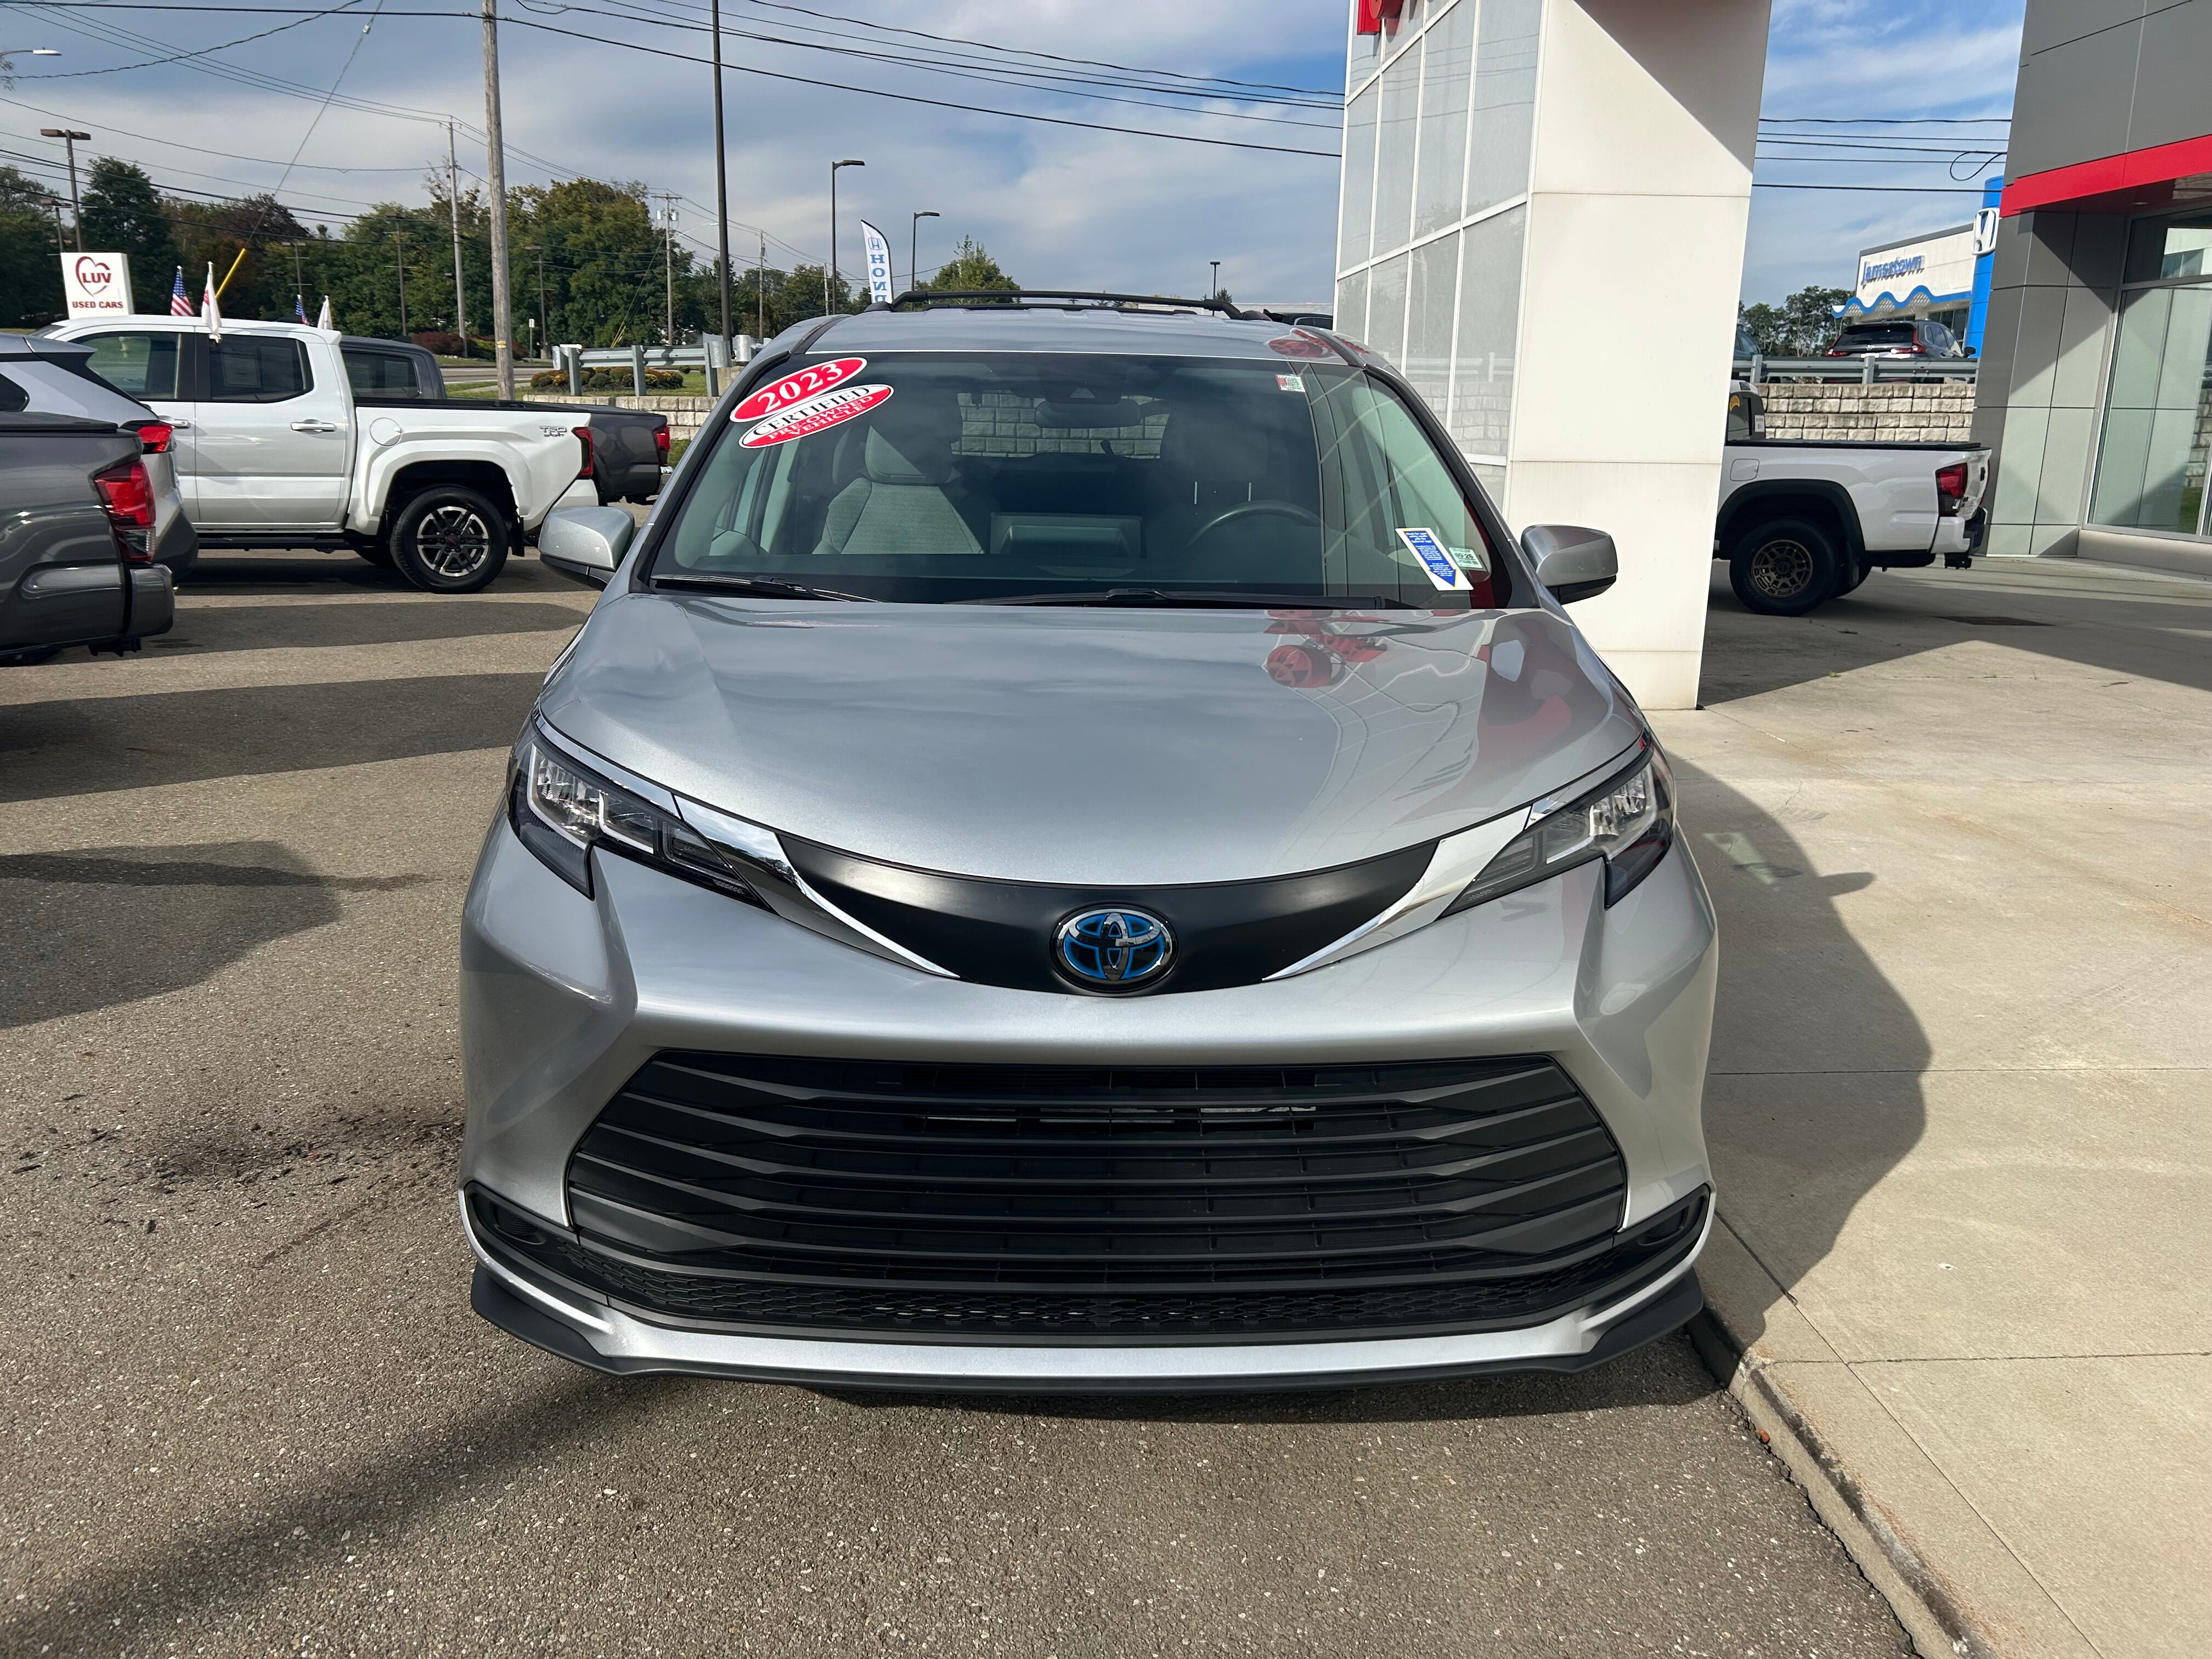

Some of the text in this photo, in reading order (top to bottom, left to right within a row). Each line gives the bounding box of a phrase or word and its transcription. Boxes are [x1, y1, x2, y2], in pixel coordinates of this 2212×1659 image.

[82, 273, 112, 283] LUV
[1861, 255, 1923, 285] Jamestown
[757, 363, 843, 413] 2023
[753, 387, 870, 435] CERTIFIED
[768, 396, 873, 439] PRE-OWNED
[788, 405, 866, 436] VEHICLE
[539, 426, 567, 435] TRD
